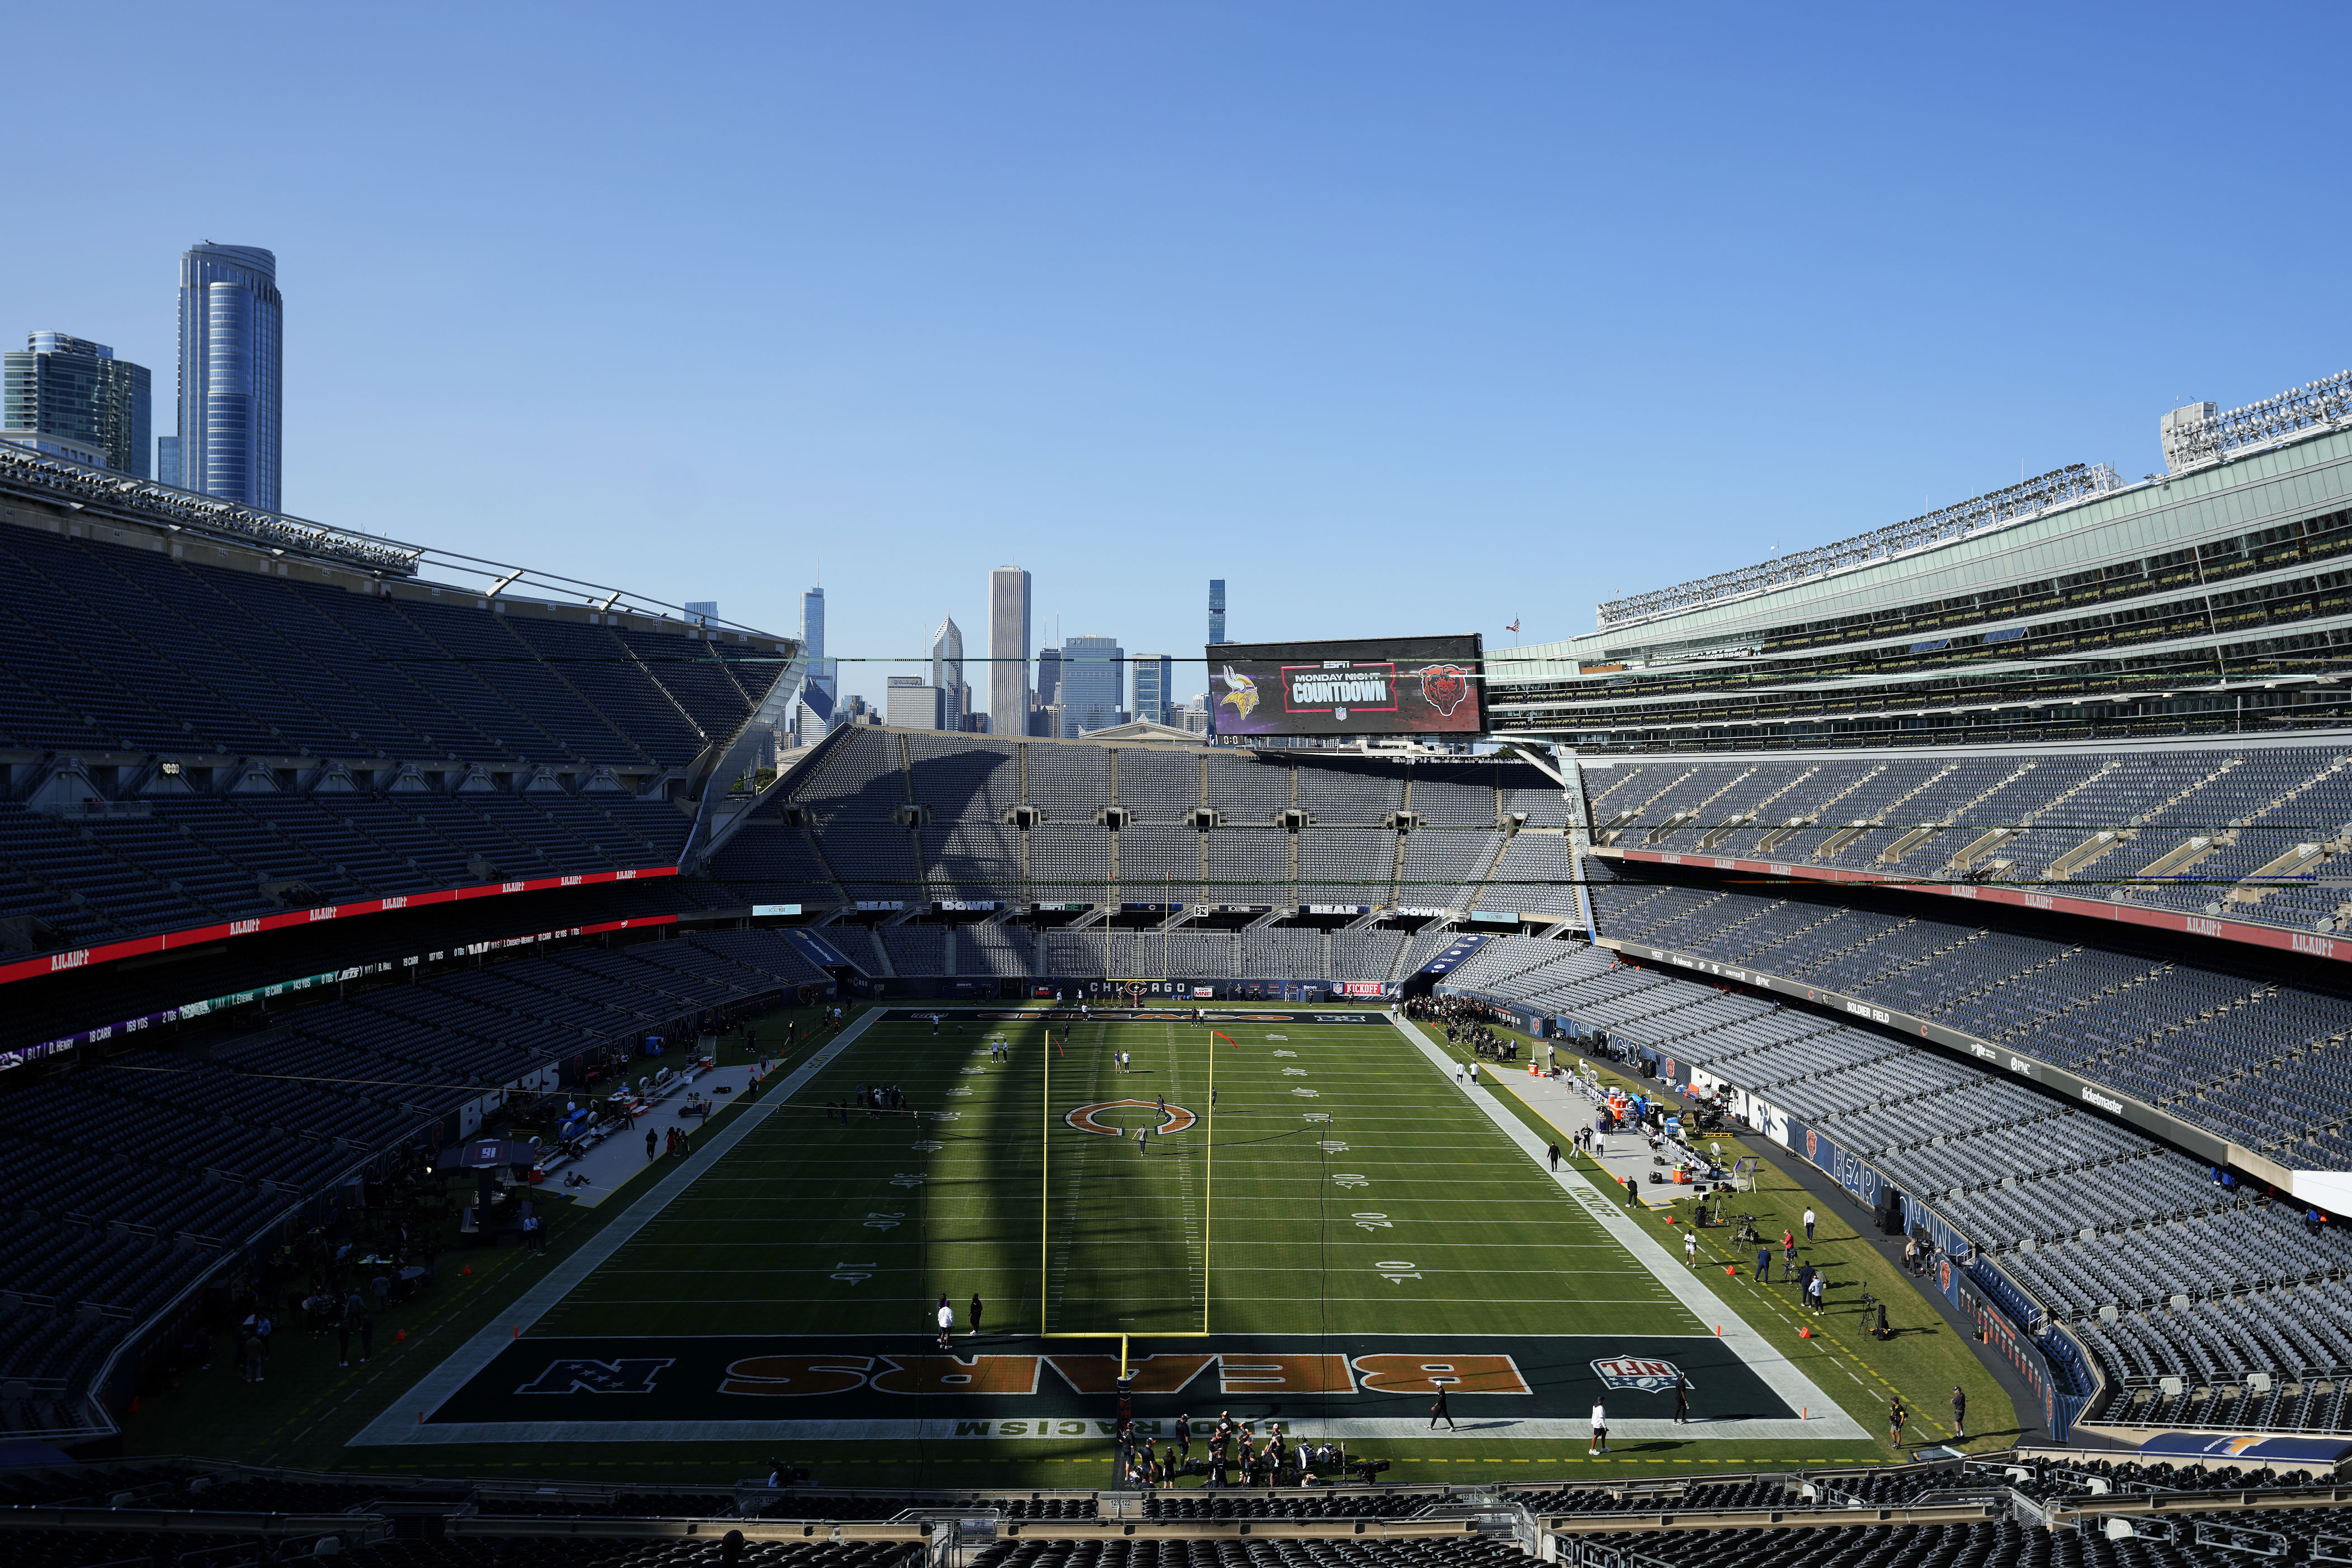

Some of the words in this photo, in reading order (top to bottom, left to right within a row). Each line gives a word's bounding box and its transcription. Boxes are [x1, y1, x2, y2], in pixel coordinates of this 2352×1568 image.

[1295, 674, 1342, 682] MONDAY
[1345, 672, 1379, 681] NIGHT
[1293, 681, 1386, 703] COUNTDOWN
[857, 901, 904, 911] BEAR
[1196, 906, 1207, 915] 34
[1310, 905, 1359, 914] BEAR
[1398, 907, 1444, 917] DOWN
[542, 931, 551, 940] CARR
[2293, 933, 2334, 957] KICKOFF
[1651, 950, 1663, 958] VIZZY
[338, 967, 360, 981] JETS
[403, 958, 408, 966] 19
[408, 955, 418, 966] CARR
[1678, 957, 1693, 967] Advocate
[1726, 969, 1740, 978] UNITED
[265, 988, 270, 997] 16
[271, 984, 282, 996] CARR
[293, 981, 301, 991] 143
[302, 978, 311, 989] YDS
[1347, 984, 1378, 993] KICKOFF
[1761, 977, 1770, 986] PNC
[976, 1012, 1295, 1021] CHICAGO
[1847, 1001, 1871, 1018] SOLDIER
[1873, 1009, 1889, 1023] FIELD
[27, 1046, 41, 1061] BLT
[49, 1045, 55, 1055] D.
[56, 1038, 74, 1052] HENRY
[89, 1031, 96, 1043] 18
[96, 1027, 112, 1040] CARR
[126, 1021, 136, 1033] 169
[137, 1017, 148, 1029] YDS
[162, 1014, 167, 1023] 2
[2018, 1060, 2030, 1075] PNC
[2082, 1086, 2123, 1114] ticketmaster
[889, 1173, 928, 1185] 30
[1332, 1174, 1369, 1186] 30
[1834, 1144, 1875, 1207] BEAR
[1569, 1186, 1622, 1217] KICKOFF
[863, 1212, 906, 1228] 20
[1351, 1212, 1393, 1227] 20
[830, 1262, 877, 1280] 10
[1376, 1261, 1422, 1279] 10
[716, 1353, 1534, 1397] BEARS
[1600, 1361, 1670, 1376] NFL
